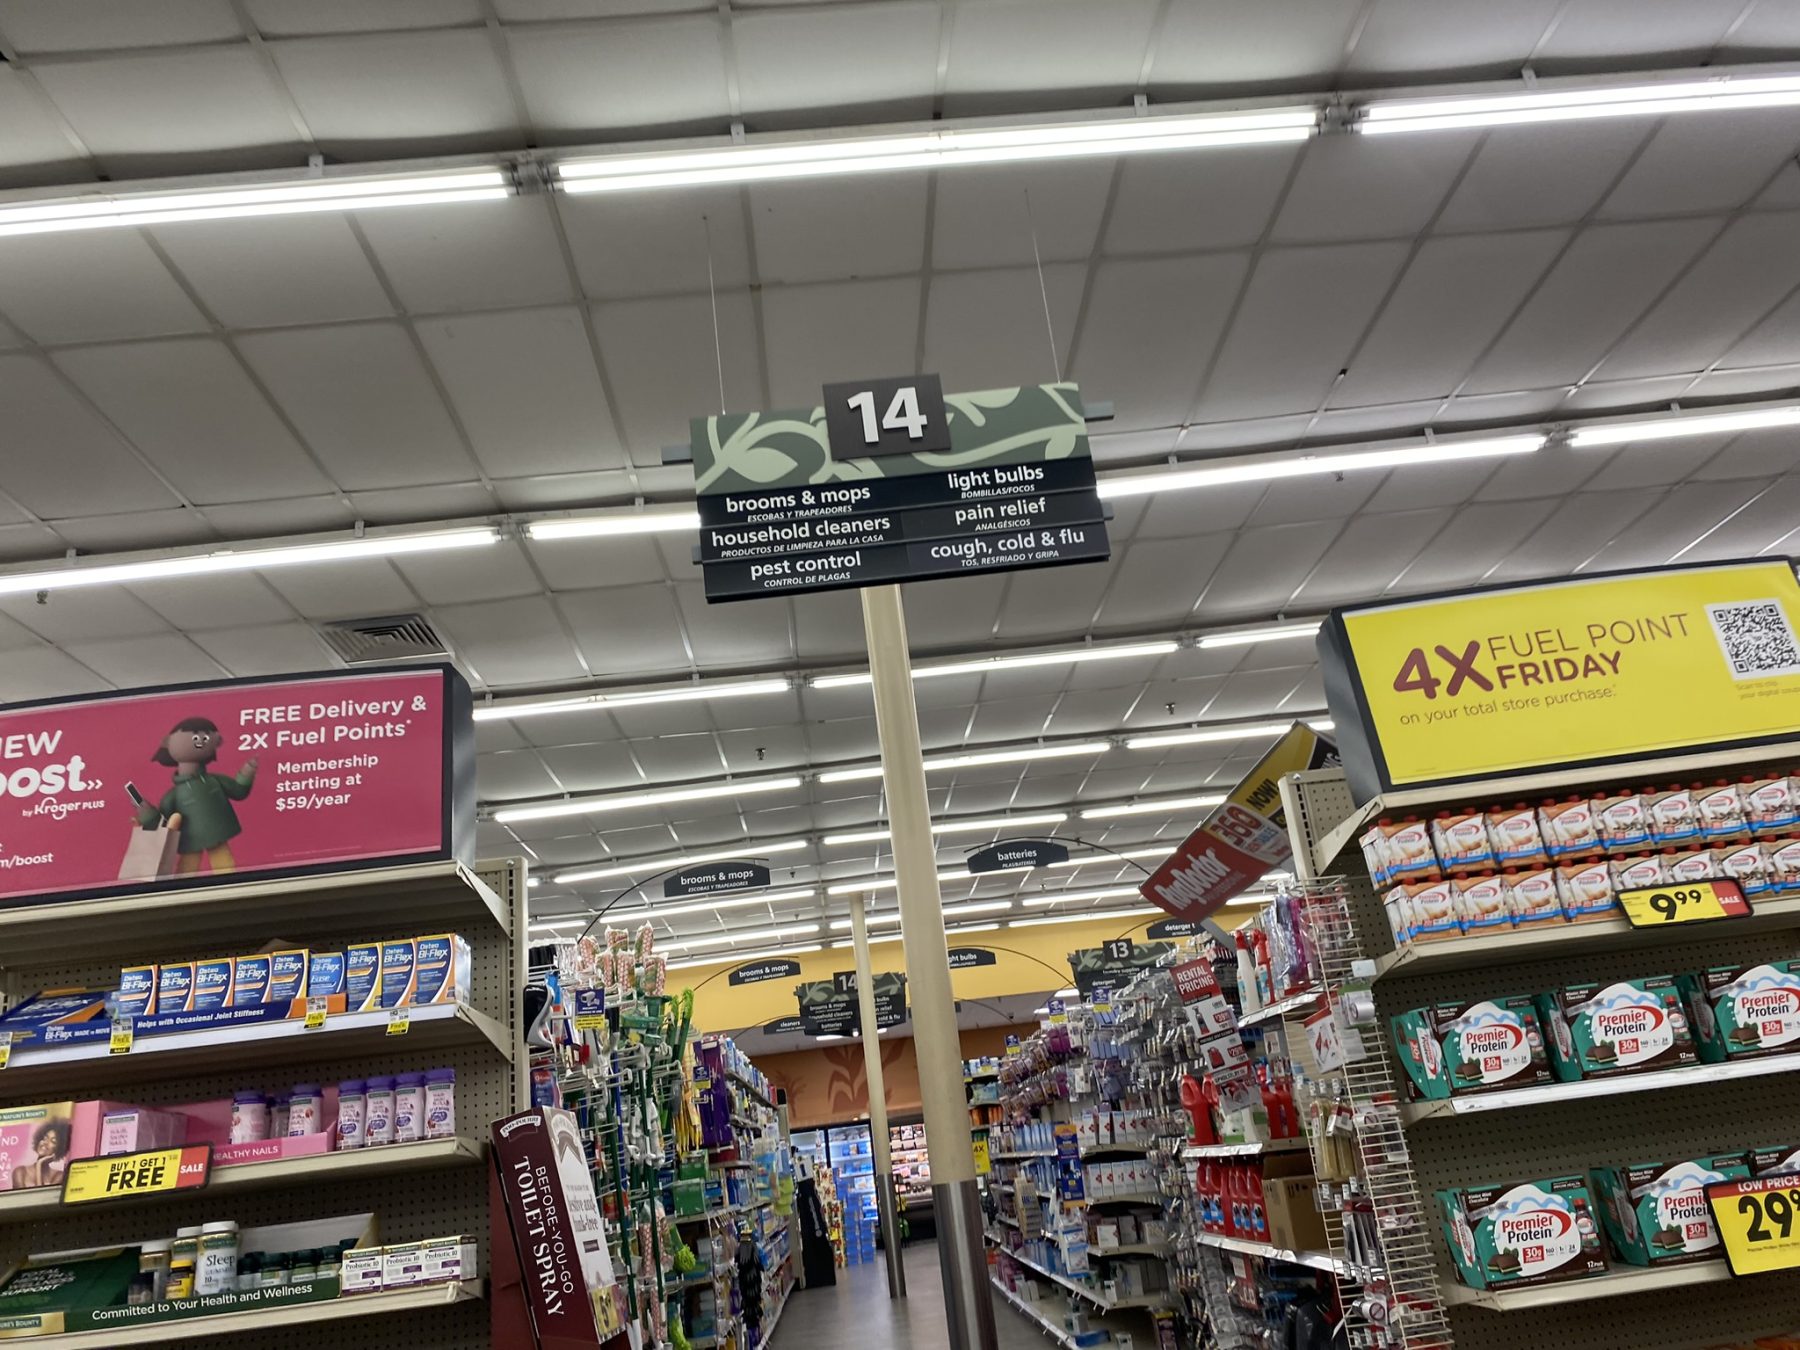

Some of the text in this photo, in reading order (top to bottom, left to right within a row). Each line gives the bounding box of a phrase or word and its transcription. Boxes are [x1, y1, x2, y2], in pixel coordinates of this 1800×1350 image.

[847, 387, 928, 444] 14
[948, 465, 1044, 491] light bulbs
[725, 487, 871, 513] brooms & mops
[747, 505, 852, 523] ESCOBAS Y TRAPEADORES
[955, 497, 1046, 525] pain relief
[711, 516, 891, 547] household cleaners
[721, 546, 772, 558] PRODUCTOS
[786, 540, 823, 552] LIMPIEZA
[825, 538, 848, 547] PARA
[861, 534, 884, 543] CASA
[930, 528, 1085, 558] cough, cold & flu
[750, 551, 862, 580] pest control
[981, 553, 1026, 565] RESFRIADO
[1035, 550, 1059, 559] GRIPA
[764, 571, 851, 588] CONTROL DE PLAGAS
[1392, 613, 1692, 700] 4X FUEL POINT
[1496, 650, 1622, 689] FRIDAY
[240, 695, 427, 727] FREE Delivery &
[1400, 709, 1420, 726] on
[1424, 706, 1459, 725] your
[1463, 698, 1498, 716] total
[1502, 694, 1541, 712] store
[238, 733, 270, 752] 2X
[276, 727, 326, 749] Fuel
[277, 753, 379, 775] Membership
[276, 773, 362, 795] starting at
[22, 809, 33, 818] by
[82, 800, 105, 810] PLUS
[275, 792, 351, 811] $59/year
[997, 849, 1038, 861] batteries
[680, 870, 754, 885] brooms & mops
[1718, 896, 1740, 905] SALE
[418, 948, 448, 959] Bi-Flex
[1109, 941, 1129, 959] 13
[739, 969, 763, 978] brooms
[771, 964, 789, 972] mops
[1176, 965, 1208, 983] RENTAL
[1178, 975, 1215, 995] PRICING
[1741, 992, 1790, 1009] Premier
[137, 1008, 265, 1029] Helps with Occasional Joint Stiffness
[1598, 1009, 1647, 1027] Premier
[1747, 1004, 1790, 1019] Protein
[1466, 1028, 1508, 1045] Premier
[1604, 1021, 1647, 1037] Protein
[1471, 1040, 1508, 1054] Protein
[252, 1145, 279, 1156] NAILS
[110, 1162, 130, 1172] BUY
[132, 1160, 136, 1169] 1
[139, 1157, 159, 1168] GET
[180, 1163, 204, 1174] SALE
[106, 1167, 165, 1192] FREE
[1738, 1175, 1800, 1192] LOW PRICE
[1502, 1214, 1553, 1233] Premier
[514, 1156, 546, 1237] TOILET
[533, 1242, 564, 1316] SPRAY
[1508, 1228, 1552, 1244] Protein
[206, 1254, 235, 1267] Sleep
[92, 1283, 313, 1321] Committed to Your Health and Wellness
